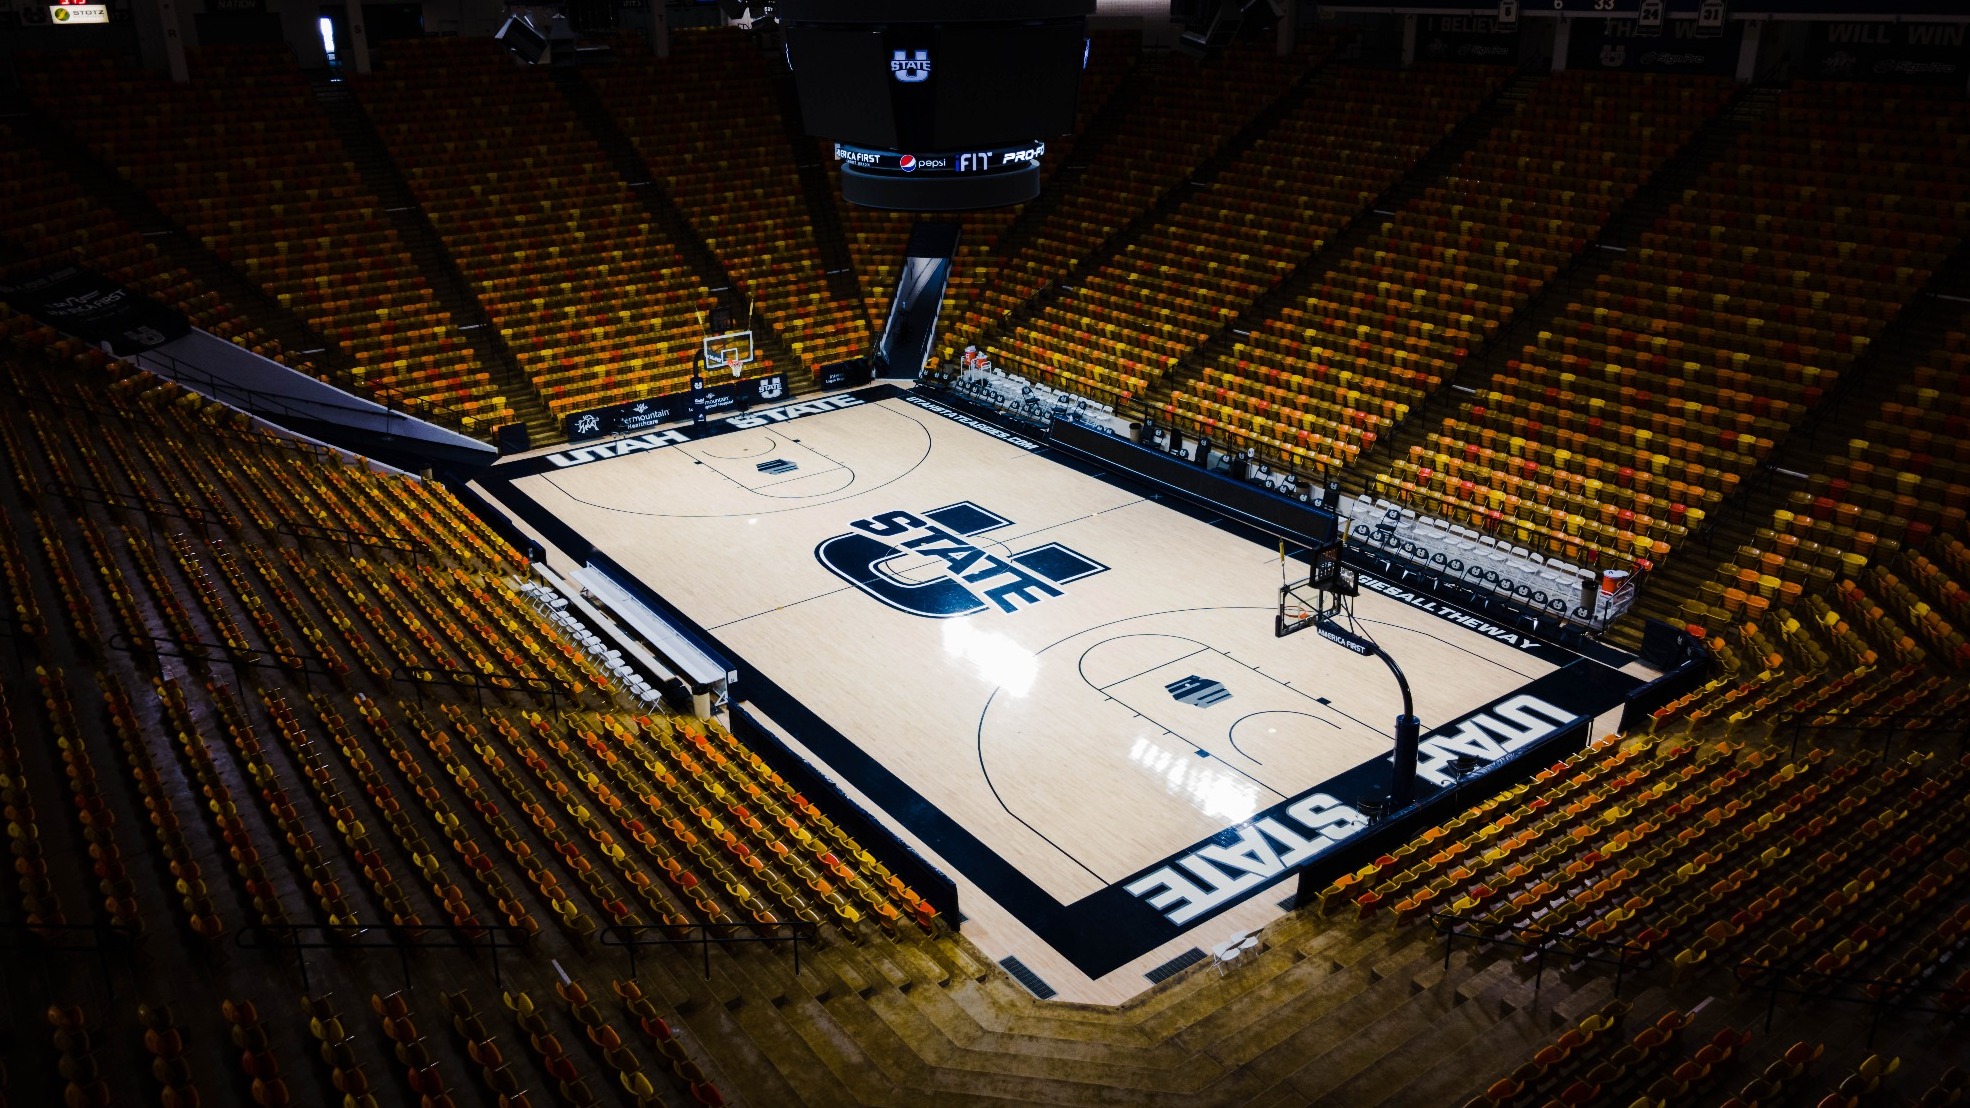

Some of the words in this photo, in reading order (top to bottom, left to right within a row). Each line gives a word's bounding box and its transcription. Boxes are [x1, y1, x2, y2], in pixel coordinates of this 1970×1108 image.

[1643, 9, 1659, 20] 24
[1703, 9, 1720, 21] 31
[1827, 23, 1891, 44] WILL
[1907, 24, 1965, 46] WIN
[890, 60, 932, 72] STATE
[857, 152, 881, 164] FIRST
[918, 159, 946, 168] pepsi
[955, 152, 993, 172] iFIT
[758, 382, 783, 394] STATE
[724, 393, 866, 429] STATE
[627, 419, 659, 430] Healthcare
[906, 396, 1040, 450] UTAHSTATEAGGIES.COM
[545, 430, 692, 468] UTAH
[848, 509, 1067, 616] STATE
[1317, 628, 1346, 647] AMERICA
[1346, 640, 1366, 654] FIRST
[1122, 792, 1368, 926] STATE
